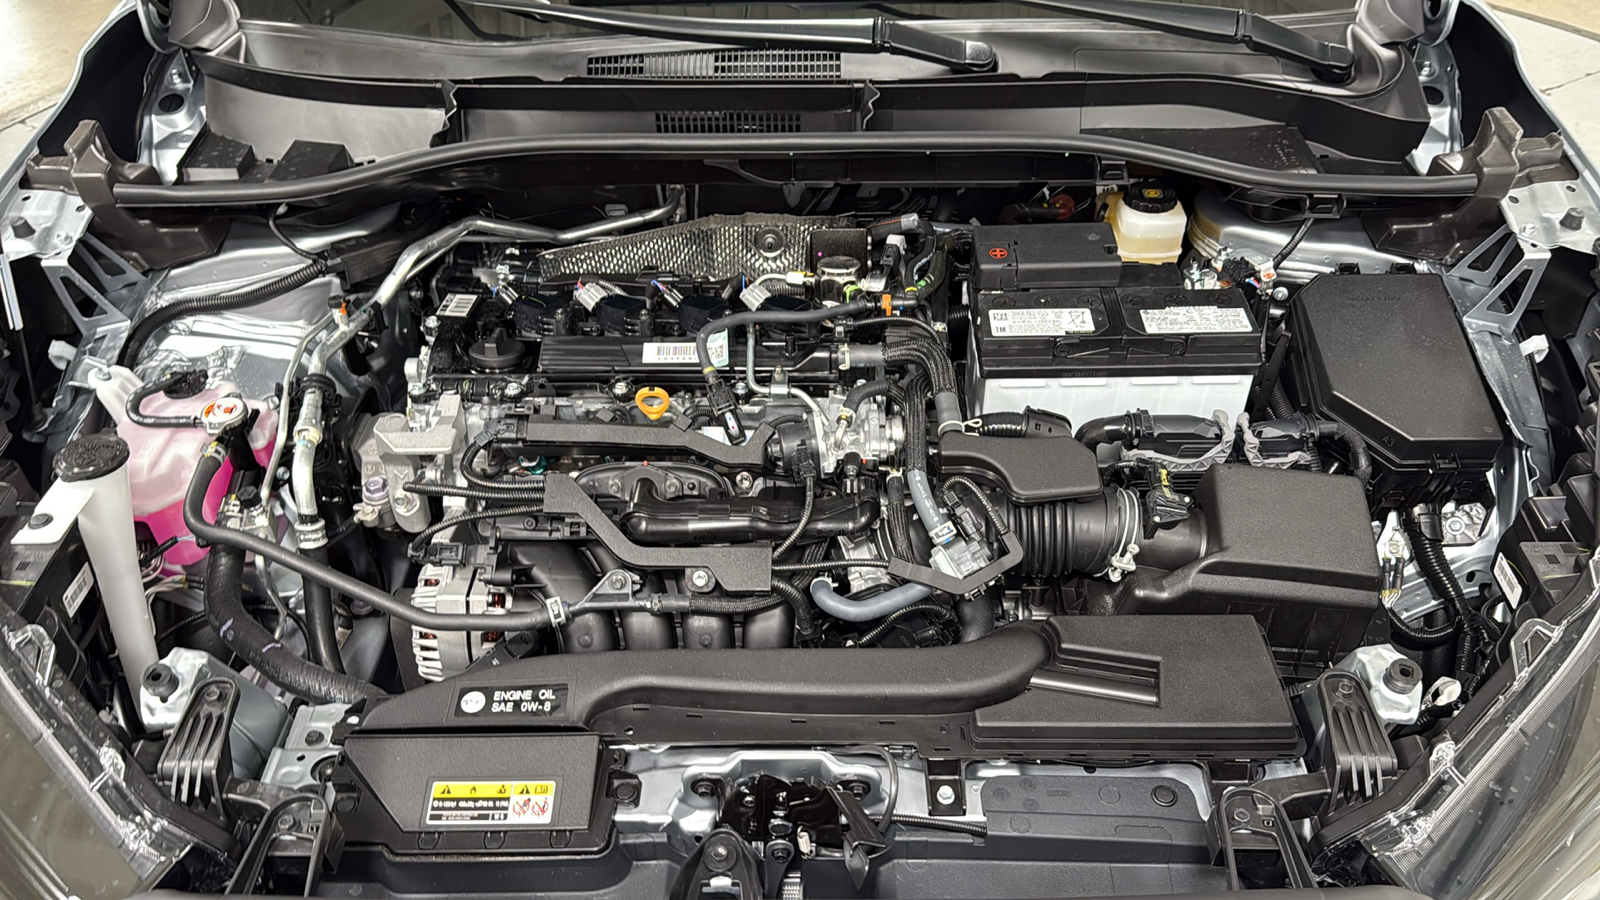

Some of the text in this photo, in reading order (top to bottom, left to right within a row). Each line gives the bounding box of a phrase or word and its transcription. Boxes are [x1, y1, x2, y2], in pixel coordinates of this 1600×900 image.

[494, 689, 556, 701] ENGINE OIL
[491, 702, 514, 713] SAE
[521, 701, 551, 712] 0W-8
